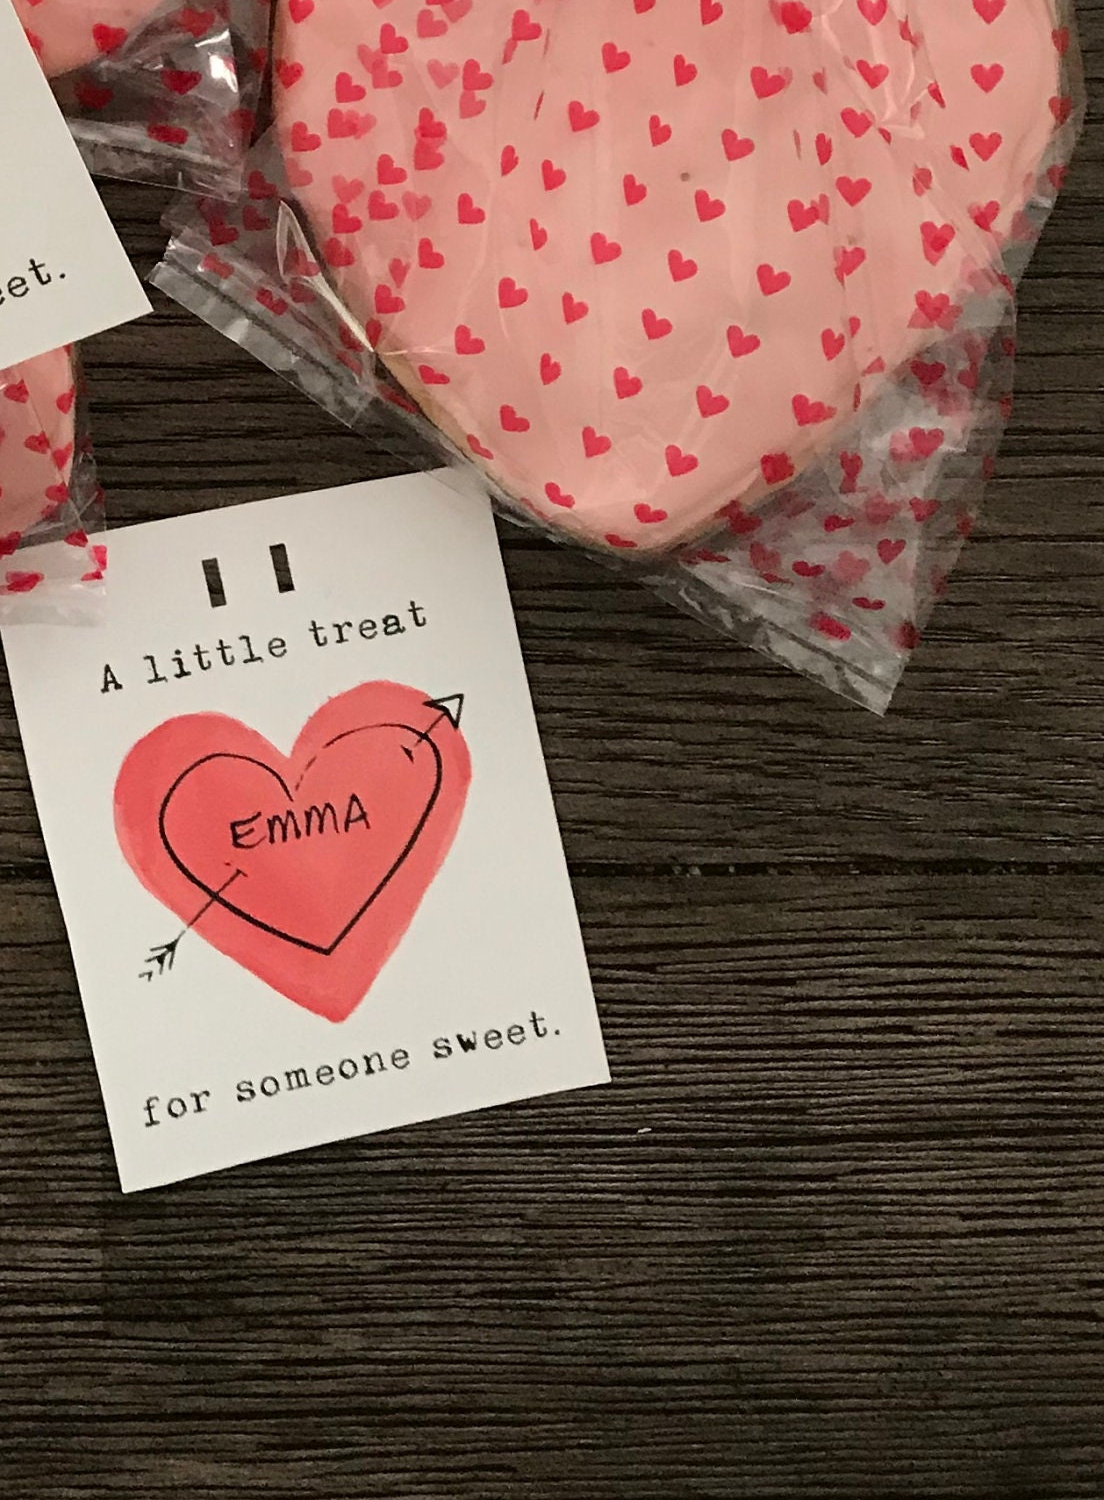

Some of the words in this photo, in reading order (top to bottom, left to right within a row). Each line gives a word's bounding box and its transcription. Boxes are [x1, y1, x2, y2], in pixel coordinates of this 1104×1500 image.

[100, 663, 124, 695] A
[145, 634, 288, 685] little
[308, 600, 427, 648] treat
[229, 793, 371, 849] EMMA
[143, 1089, 211, 1128] for
[235, 1048, 411, 1103] someone
[432, 1010, 561, 1060] sweet.
